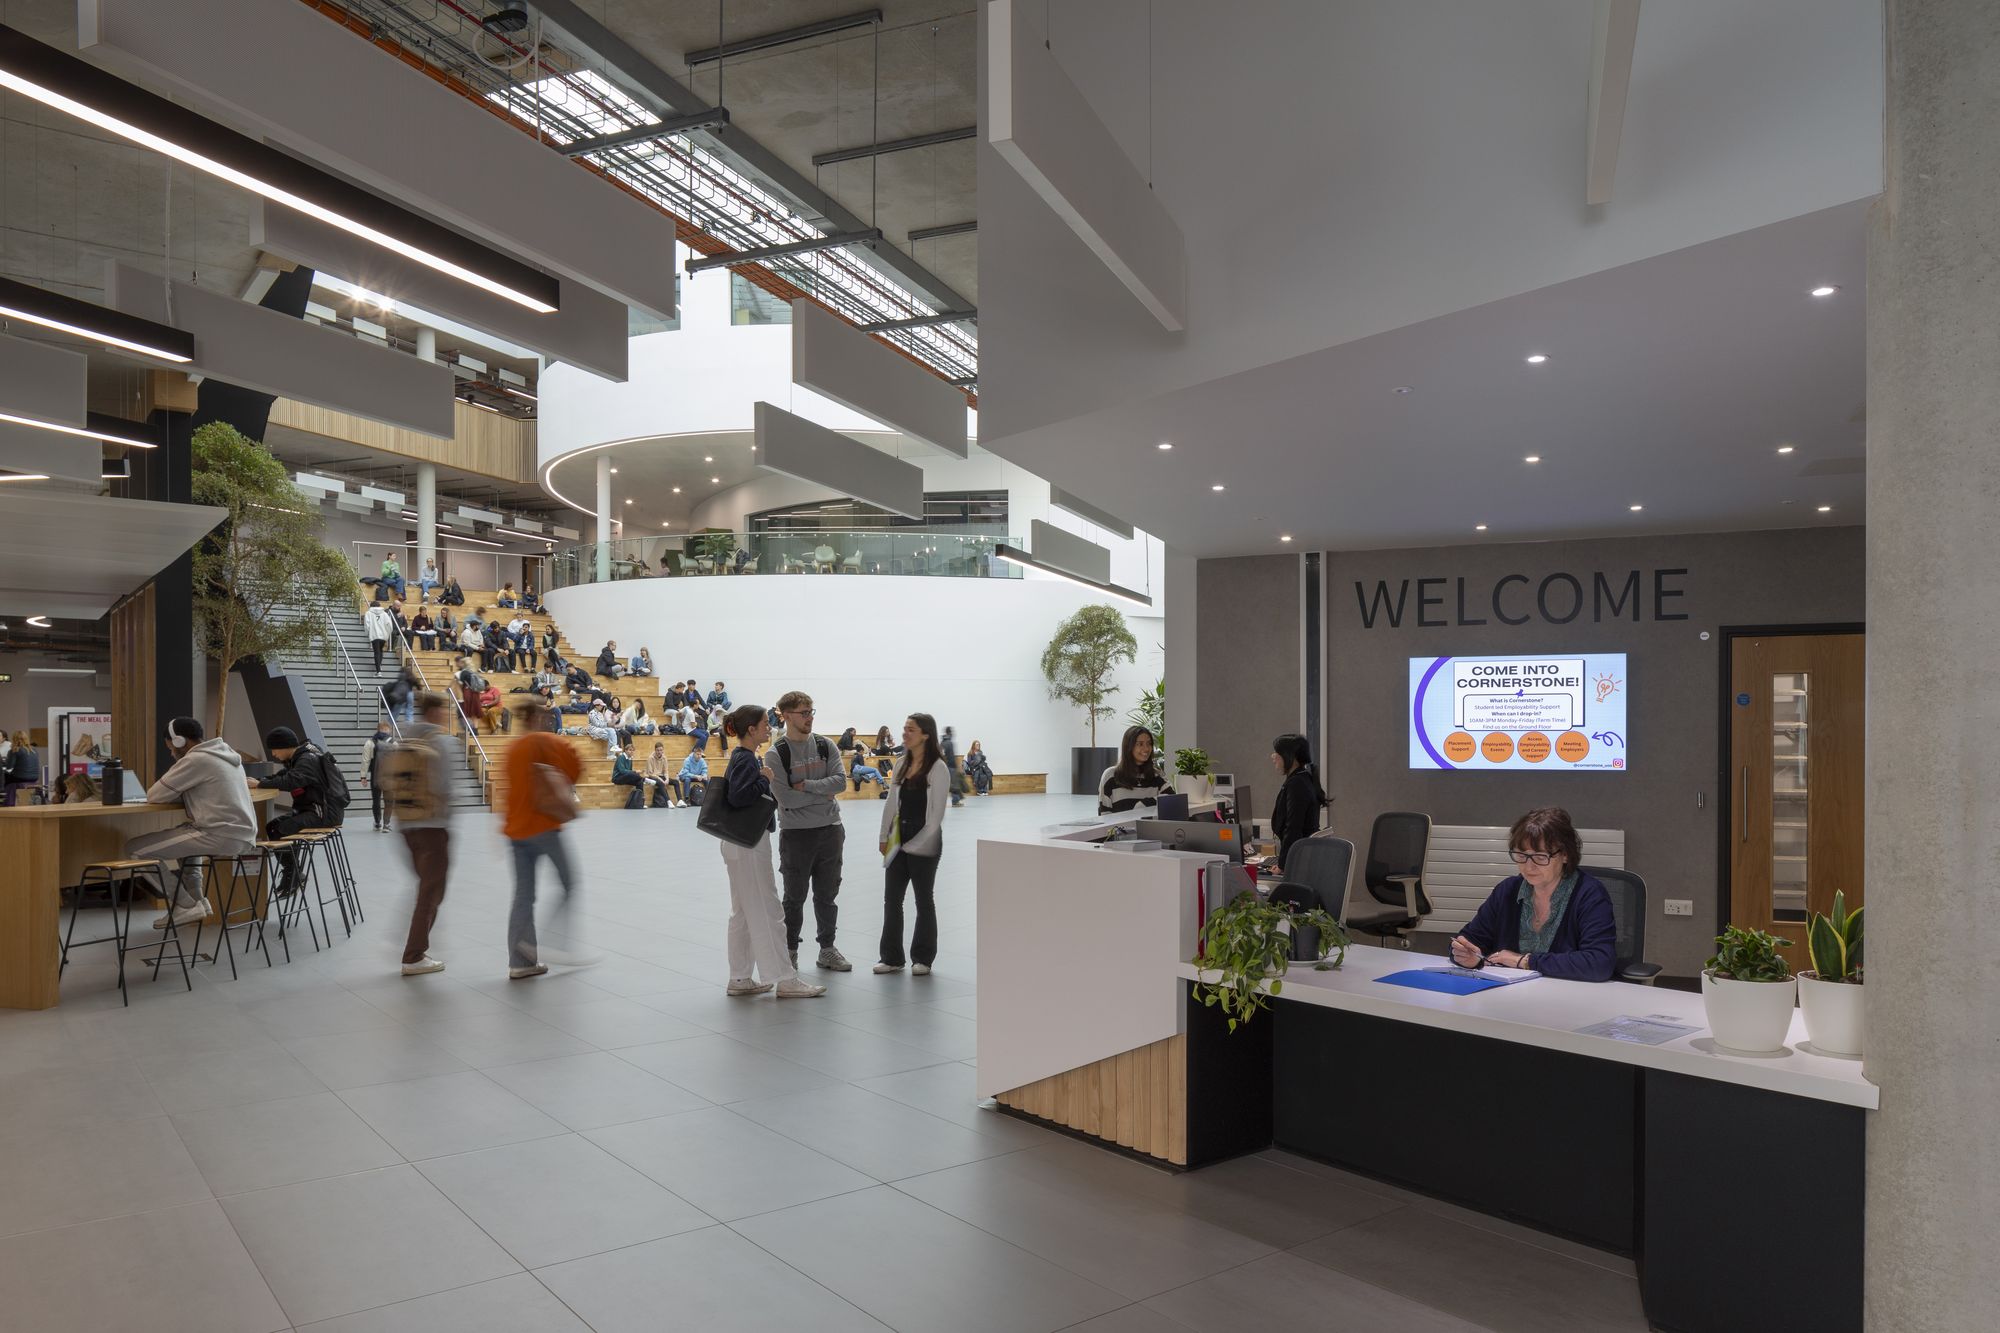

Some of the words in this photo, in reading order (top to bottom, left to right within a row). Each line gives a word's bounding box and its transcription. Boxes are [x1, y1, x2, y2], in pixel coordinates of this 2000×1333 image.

[1354, 568, 1689, 629] WELCOME
[1471, 665, 1518, 676] COME
[1523, 665, 1559, 675] INTO
[1457, 677, 1579, 688] CORNERSTONE!
